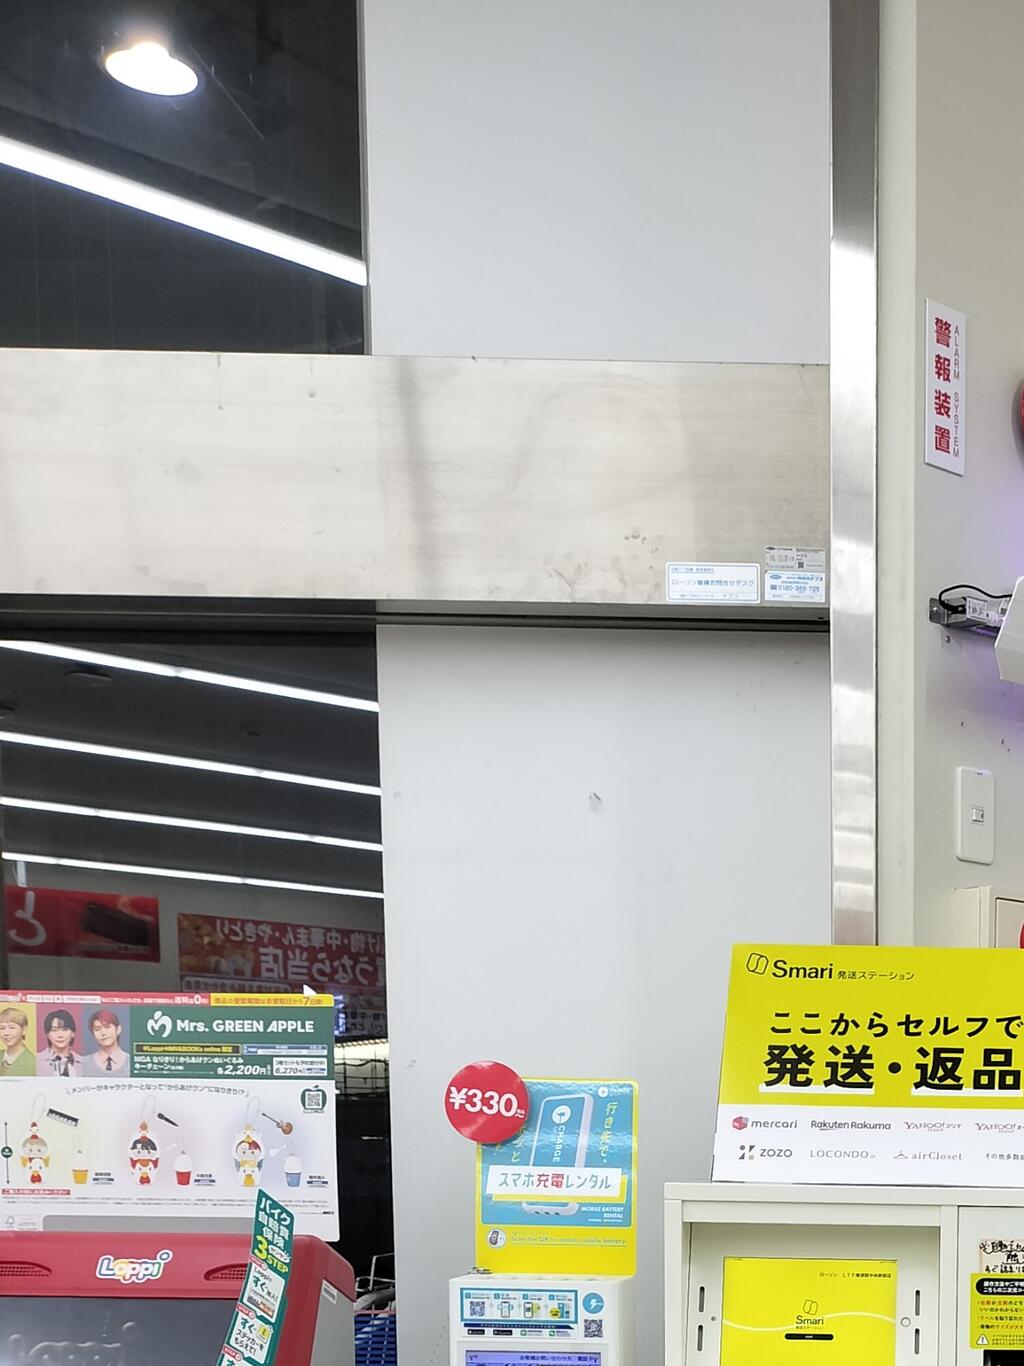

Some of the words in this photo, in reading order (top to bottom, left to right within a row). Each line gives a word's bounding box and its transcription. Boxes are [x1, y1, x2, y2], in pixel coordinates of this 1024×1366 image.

[934, 316, 951, 454] 警報装置
[772, 959, 834, 980] Smari
[837, 970, 915, 981] 発送ステーション
[177, 1020, 209, 1032] Mrs.
[213, 1020, 263, 1032] GREEN
[267, 1021, 314, 1032] APPLE
[769, 1011, 1024, 1039] ここからセルフで
[762, 1044, 1022, 1091] 発送・返品
[750, 1119, 798, 1130] mercari
[810, 1120, 850, 1131] Rakuten
[851, 1121, 891, 1131] Rakuma
[552, 1125, 565, 1162] CHARGE
[760, 1149, 793, 1158] ZOZO
[911, 1150, 962, 1161] airCloset
[499, 1172, 611, 1189] スマホ充電レンタル
[259, 1197, 291, 1226] バイク
[96, 1249, 173, 1284] Loppi
[267, 1255, 289, 1274] STEP
[795, 1315, 824, 1325] Smari
